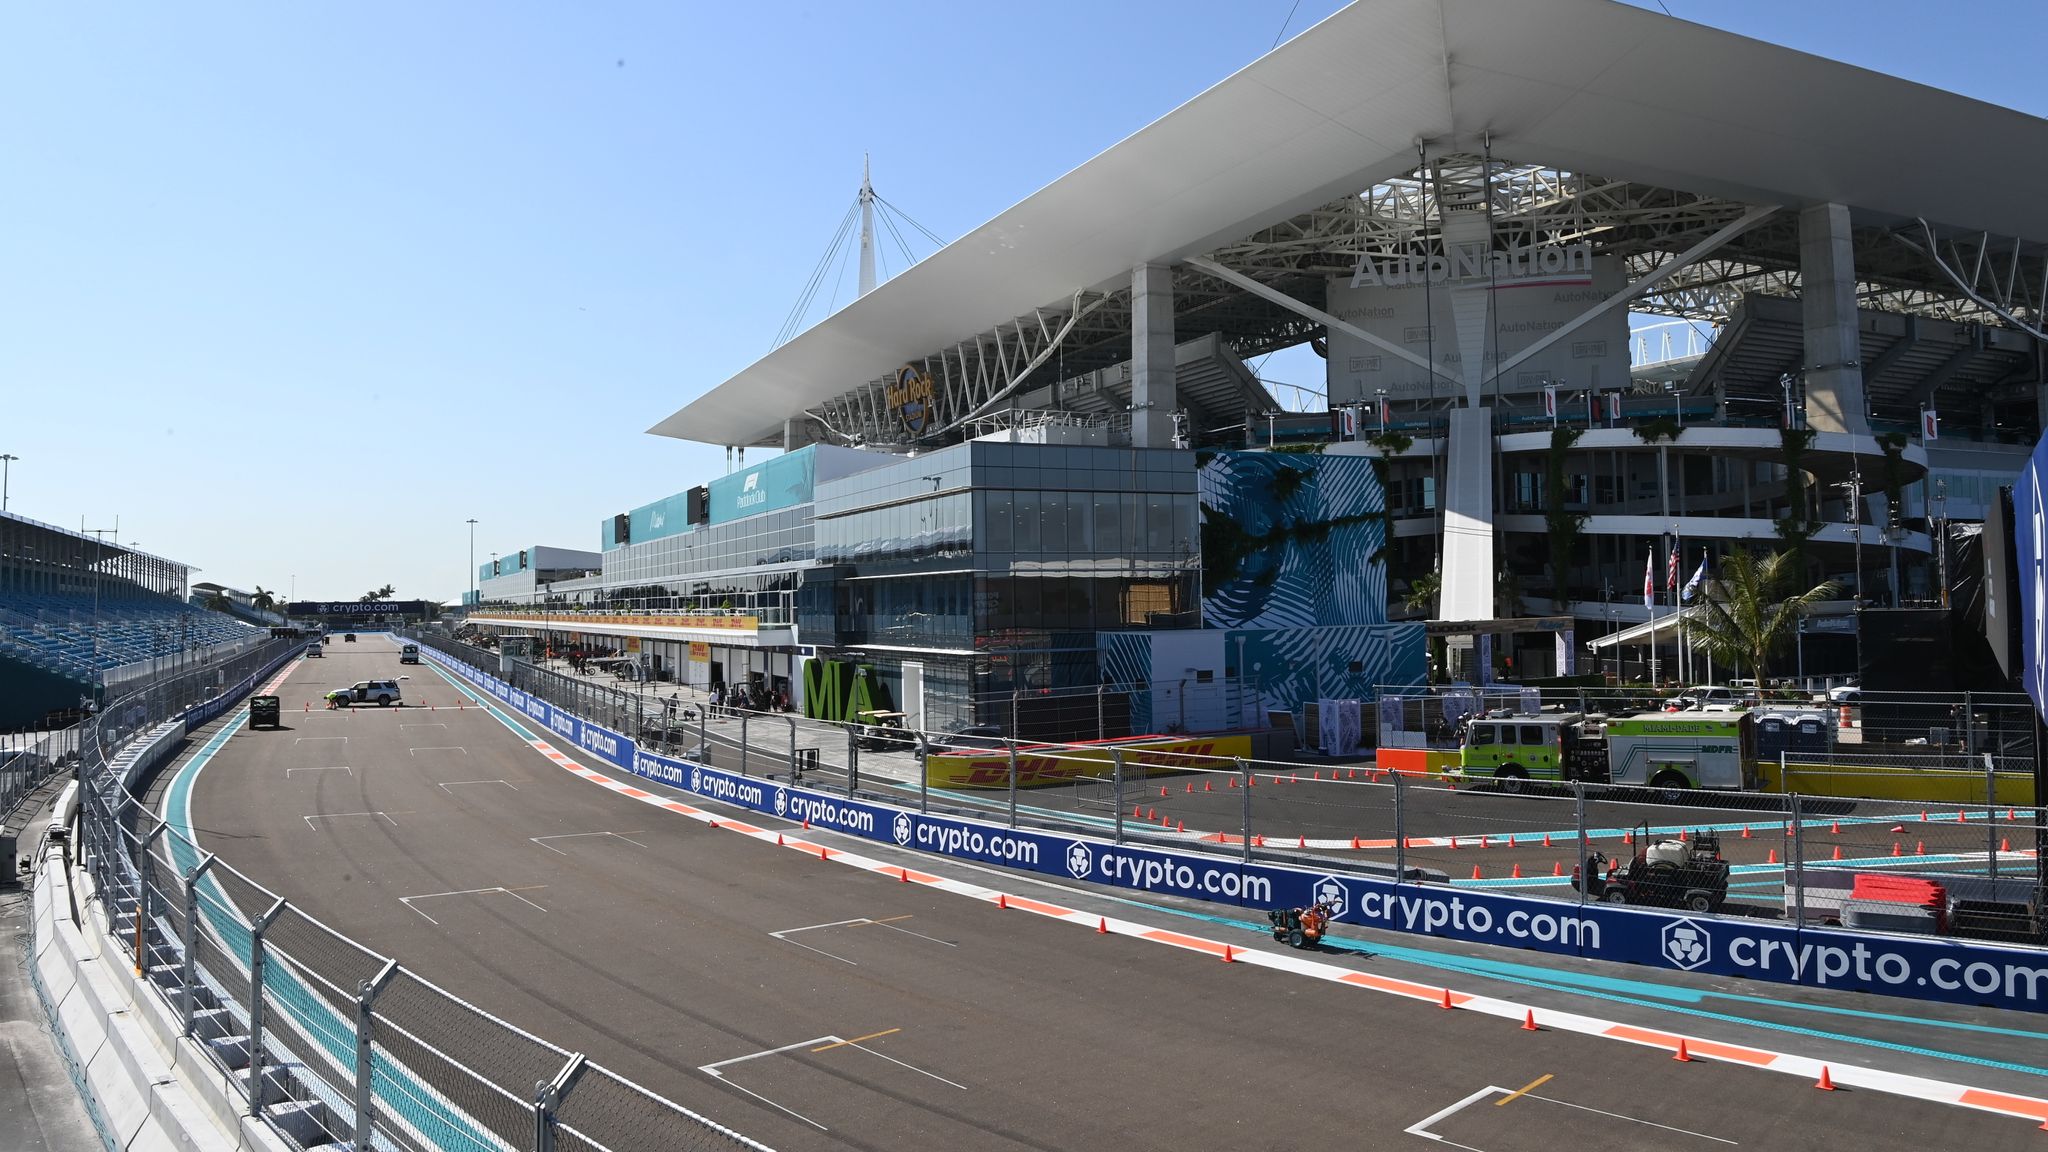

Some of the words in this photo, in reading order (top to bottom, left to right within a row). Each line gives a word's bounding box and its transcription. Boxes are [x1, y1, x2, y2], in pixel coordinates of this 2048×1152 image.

[1350, 242, 1592, 288] AutoNation
[887, 381, 908, 409] Hard
[908, 372, 933, 404] Rock
[333, 603, 399, 613] crypto.com
[803, 659, 877, 725] MIA
[587, 729, 617, 757] crypto.com
[1701, 745, 1734, 754] MDFR
[640, 758, 682, 783] crypto.com
[968, 758, 1065, 783] DHL
[703, 776, 762, 805] crypto.com
[791, 795, 873, 831] crypto.com
[917, 823, 1038, 864] crypto.com
[1100, 853, 1271, 902] crypto.com
[1361, 890, 1600, 949] crypto.com
[1728, 936, 2048, 1000] crypto.com
